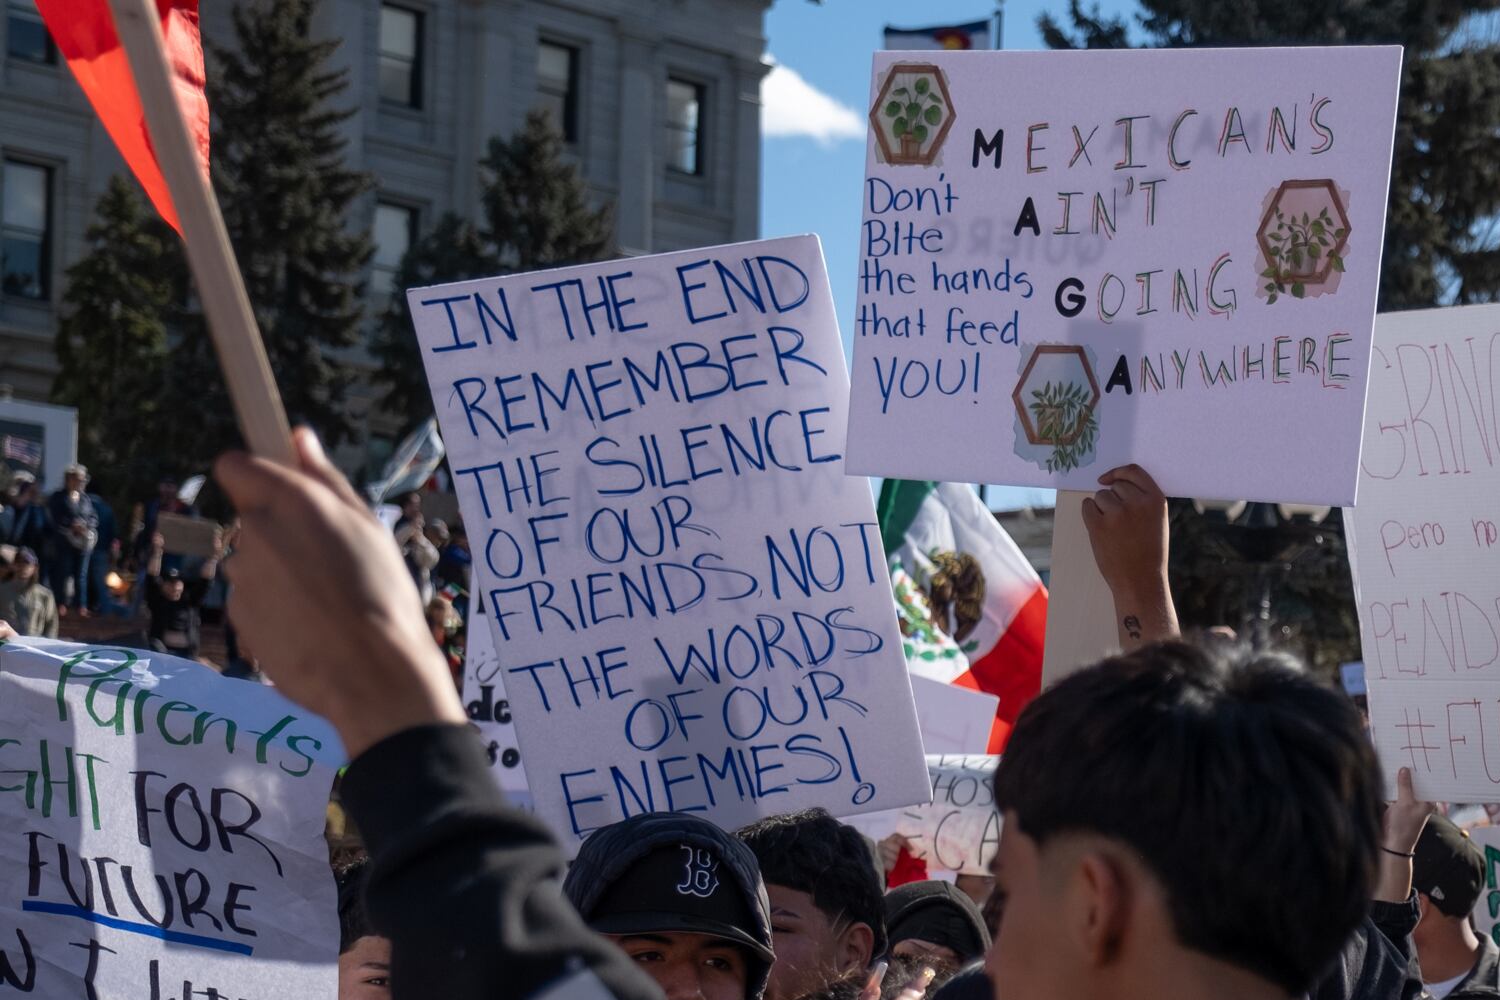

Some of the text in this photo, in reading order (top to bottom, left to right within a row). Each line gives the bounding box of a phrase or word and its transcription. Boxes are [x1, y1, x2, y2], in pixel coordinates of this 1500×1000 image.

[971, 93, 1334, 173] MEXICAN'S
[868, 173, 960, 214] Don't
[1014, 177, 1166, 239] AIN'T
[422, 256, 810, 352] IN THE END
[861, 258, 1034, 298] the hands
[1055, 253, 1237, 323] GOING
[858, 302, 1021, 347] that feed
[1105, 333, 1352, 394] ANYWHERE
[449, 326, 828, 440] REMEMBER
[456, 407, 842, 519] THE SILENCE
[486, 496, 720, 579] OF OUR
[765, 522, 879, 600] NOT
[509, 646, 633, 712] THE
[655, 607, 883, 686] WORDS
[57, 648, 322, 778] Parents
[625, 671, 868, 751] OF OUR
[130, 770, 284, 877] FOR
[560, 727, 875, 839] ENEMIES!
[23, 832, 257, 937] FUTURE
